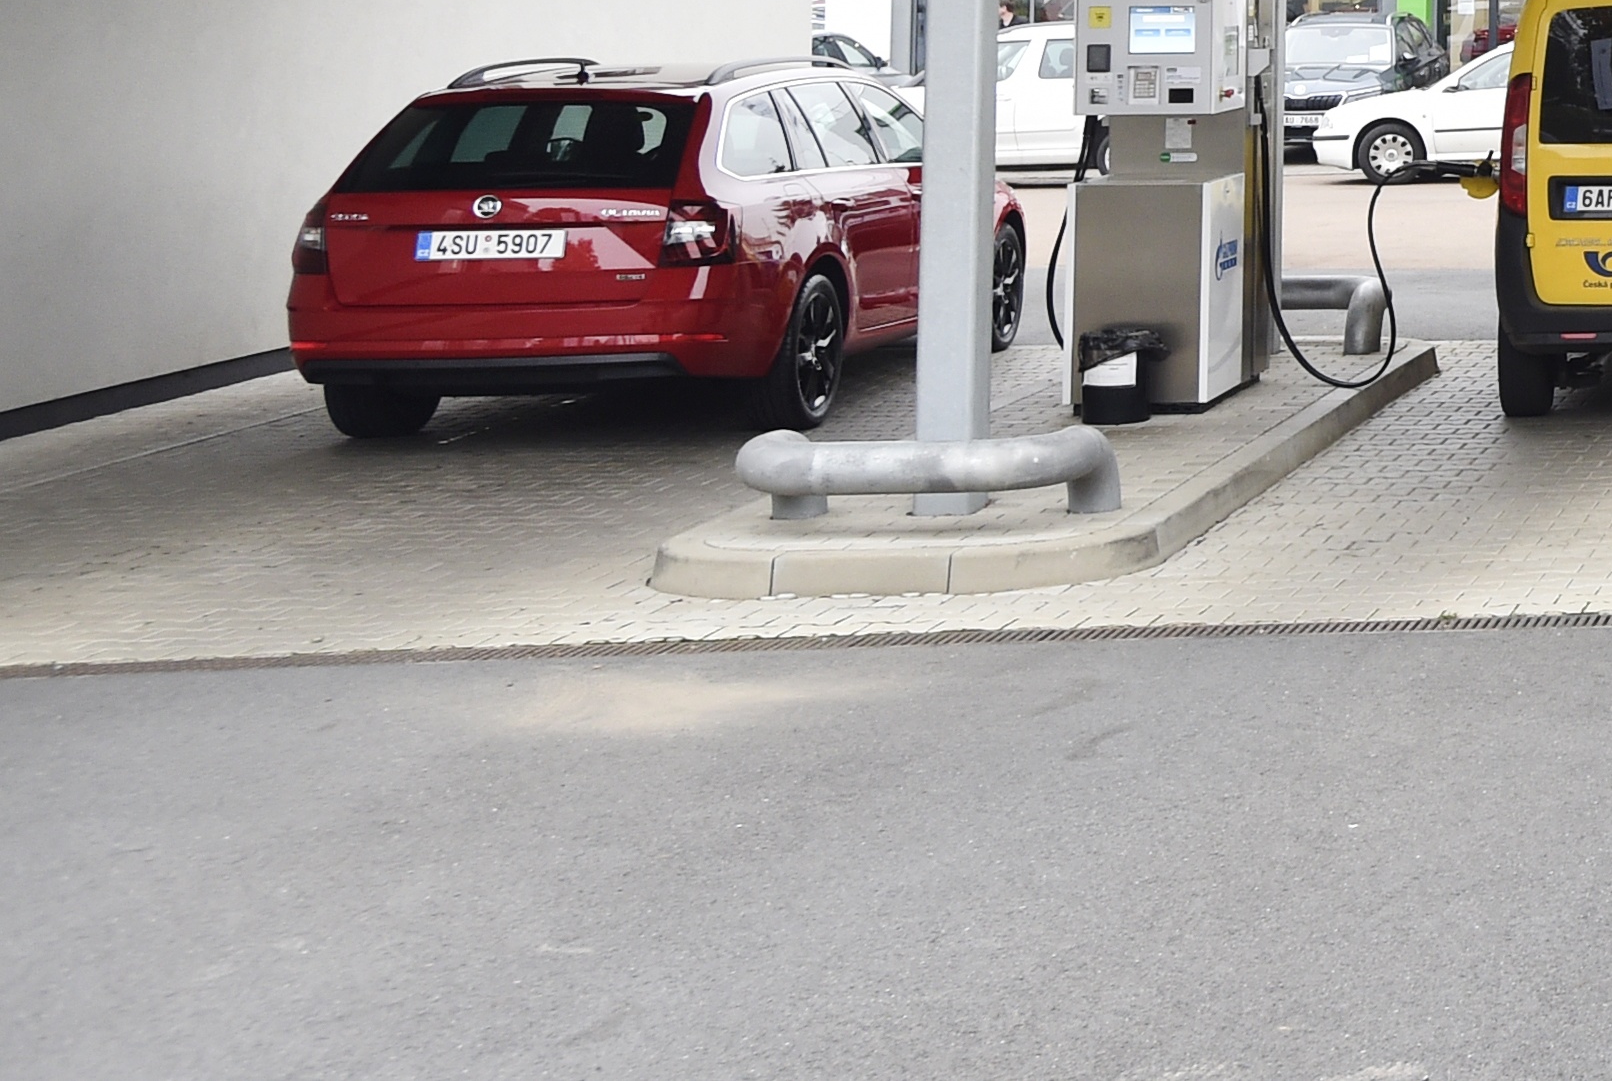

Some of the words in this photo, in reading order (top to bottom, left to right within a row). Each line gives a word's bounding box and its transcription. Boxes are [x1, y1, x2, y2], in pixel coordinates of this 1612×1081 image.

[436, 234, 479, 256] 4SU
[496, 233, 553, 255] 5907
[1582, 279, 1608, 289] Česká
